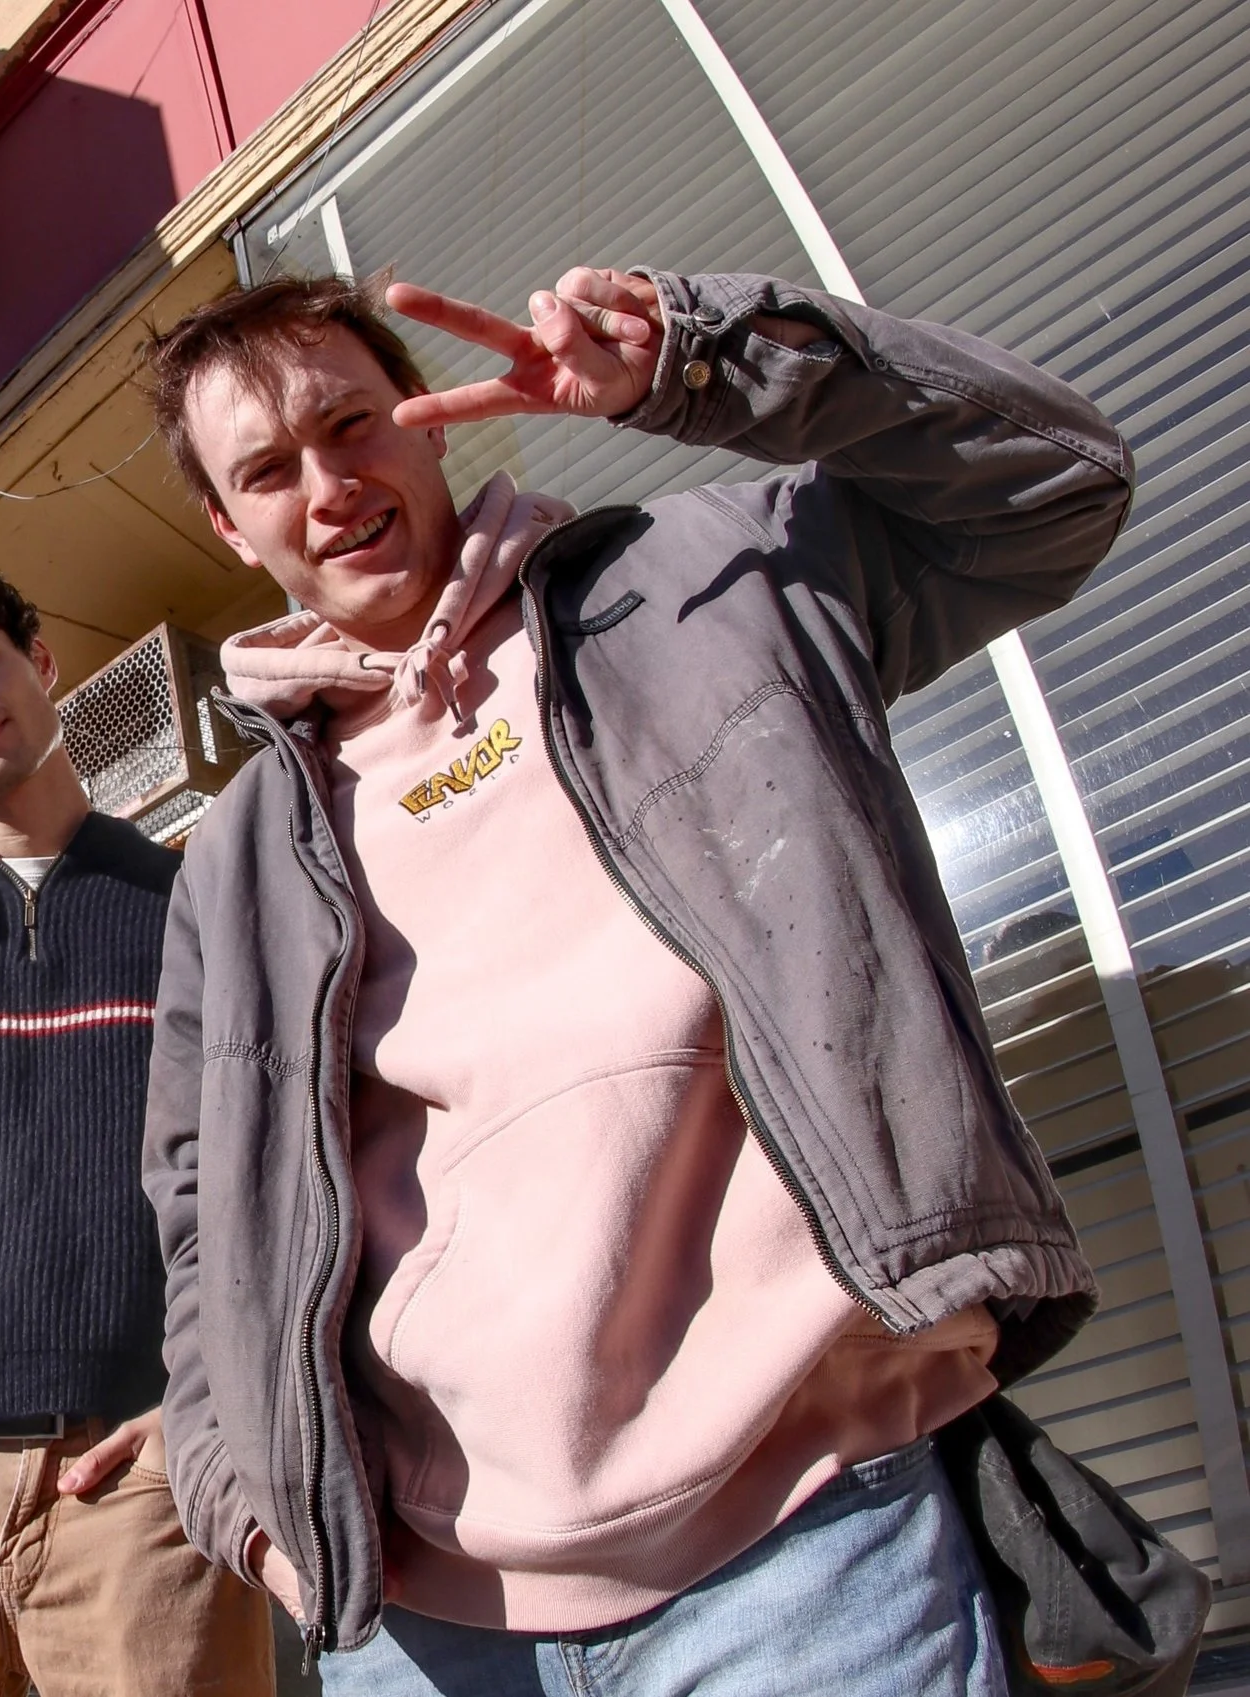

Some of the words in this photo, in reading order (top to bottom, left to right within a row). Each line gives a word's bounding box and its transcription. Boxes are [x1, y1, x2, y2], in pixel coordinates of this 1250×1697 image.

[580, 597, 634, 630] Columbia
[398, 718, 522, 815] FLAVOR
[414, 754, 519, 823] WORLD
